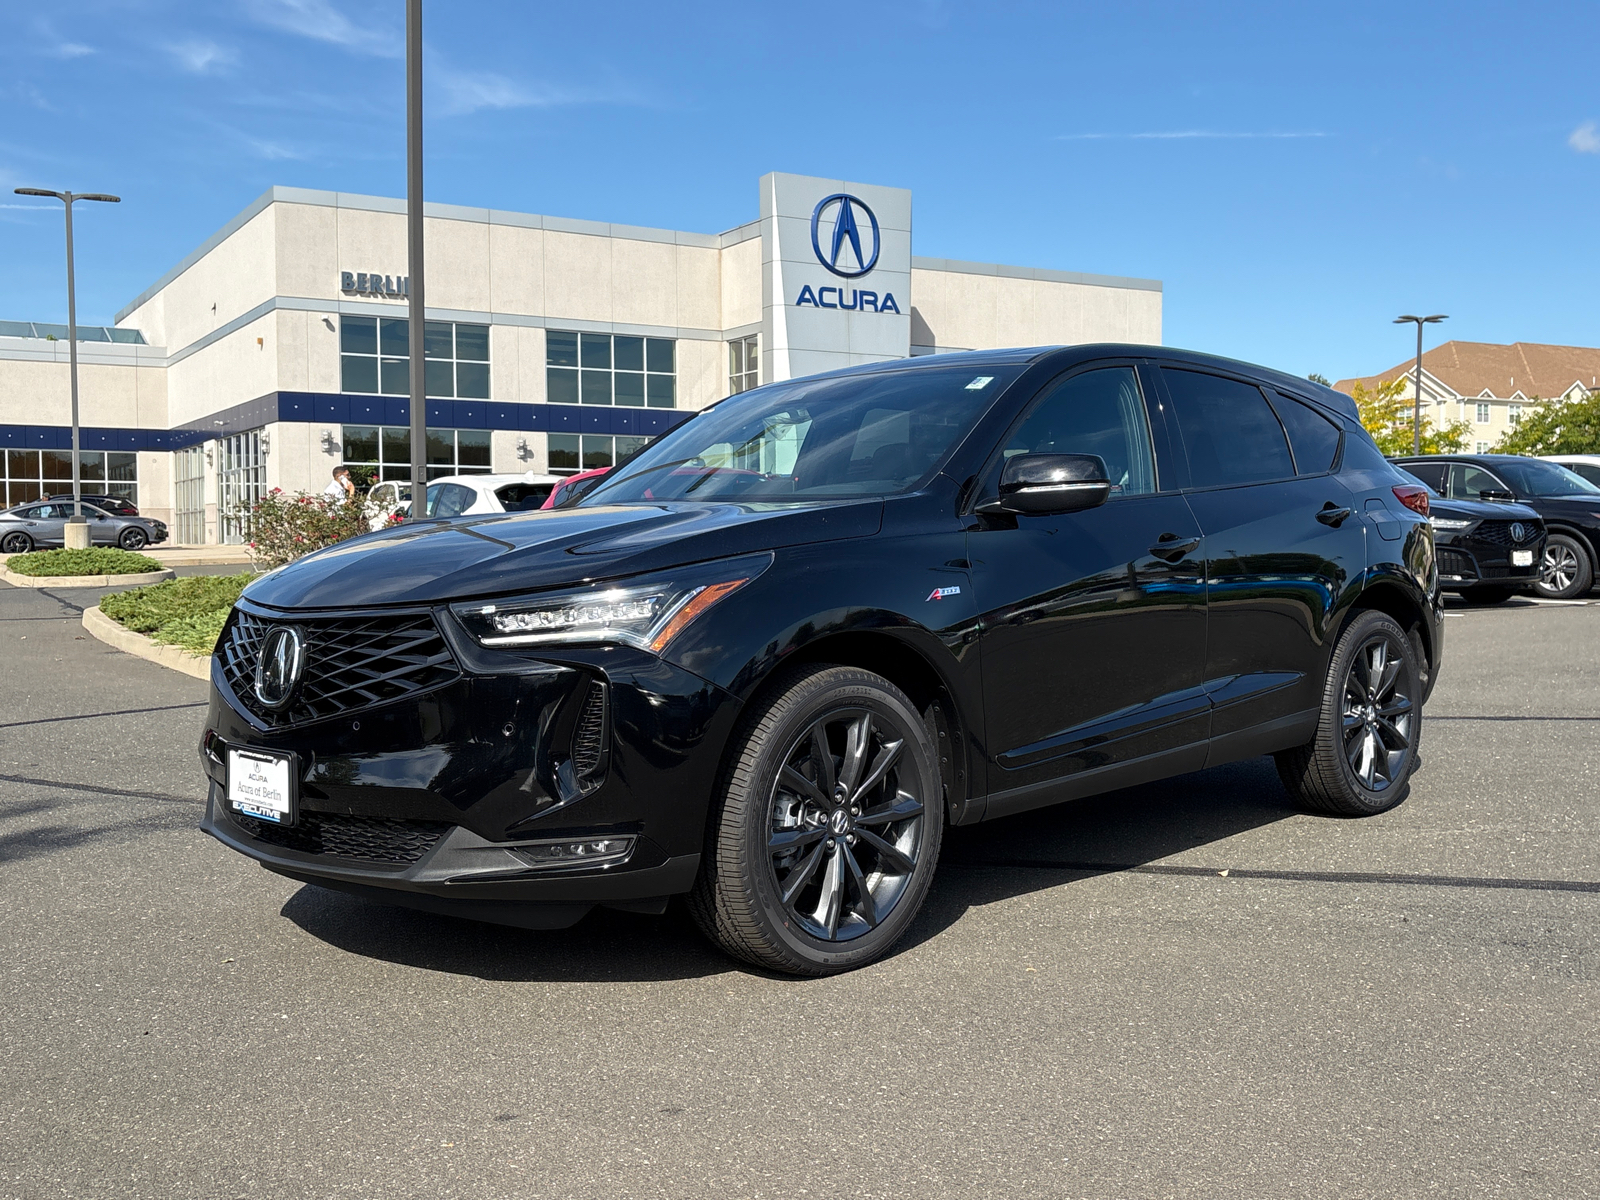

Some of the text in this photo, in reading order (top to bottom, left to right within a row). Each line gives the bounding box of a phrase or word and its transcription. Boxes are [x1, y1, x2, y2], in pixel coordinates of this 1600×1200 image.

[796, 285, 900, 314] ACURA
[248, 773, 268, 783] ACURA
[237, 781, 281, 801] Acura of Berlin
